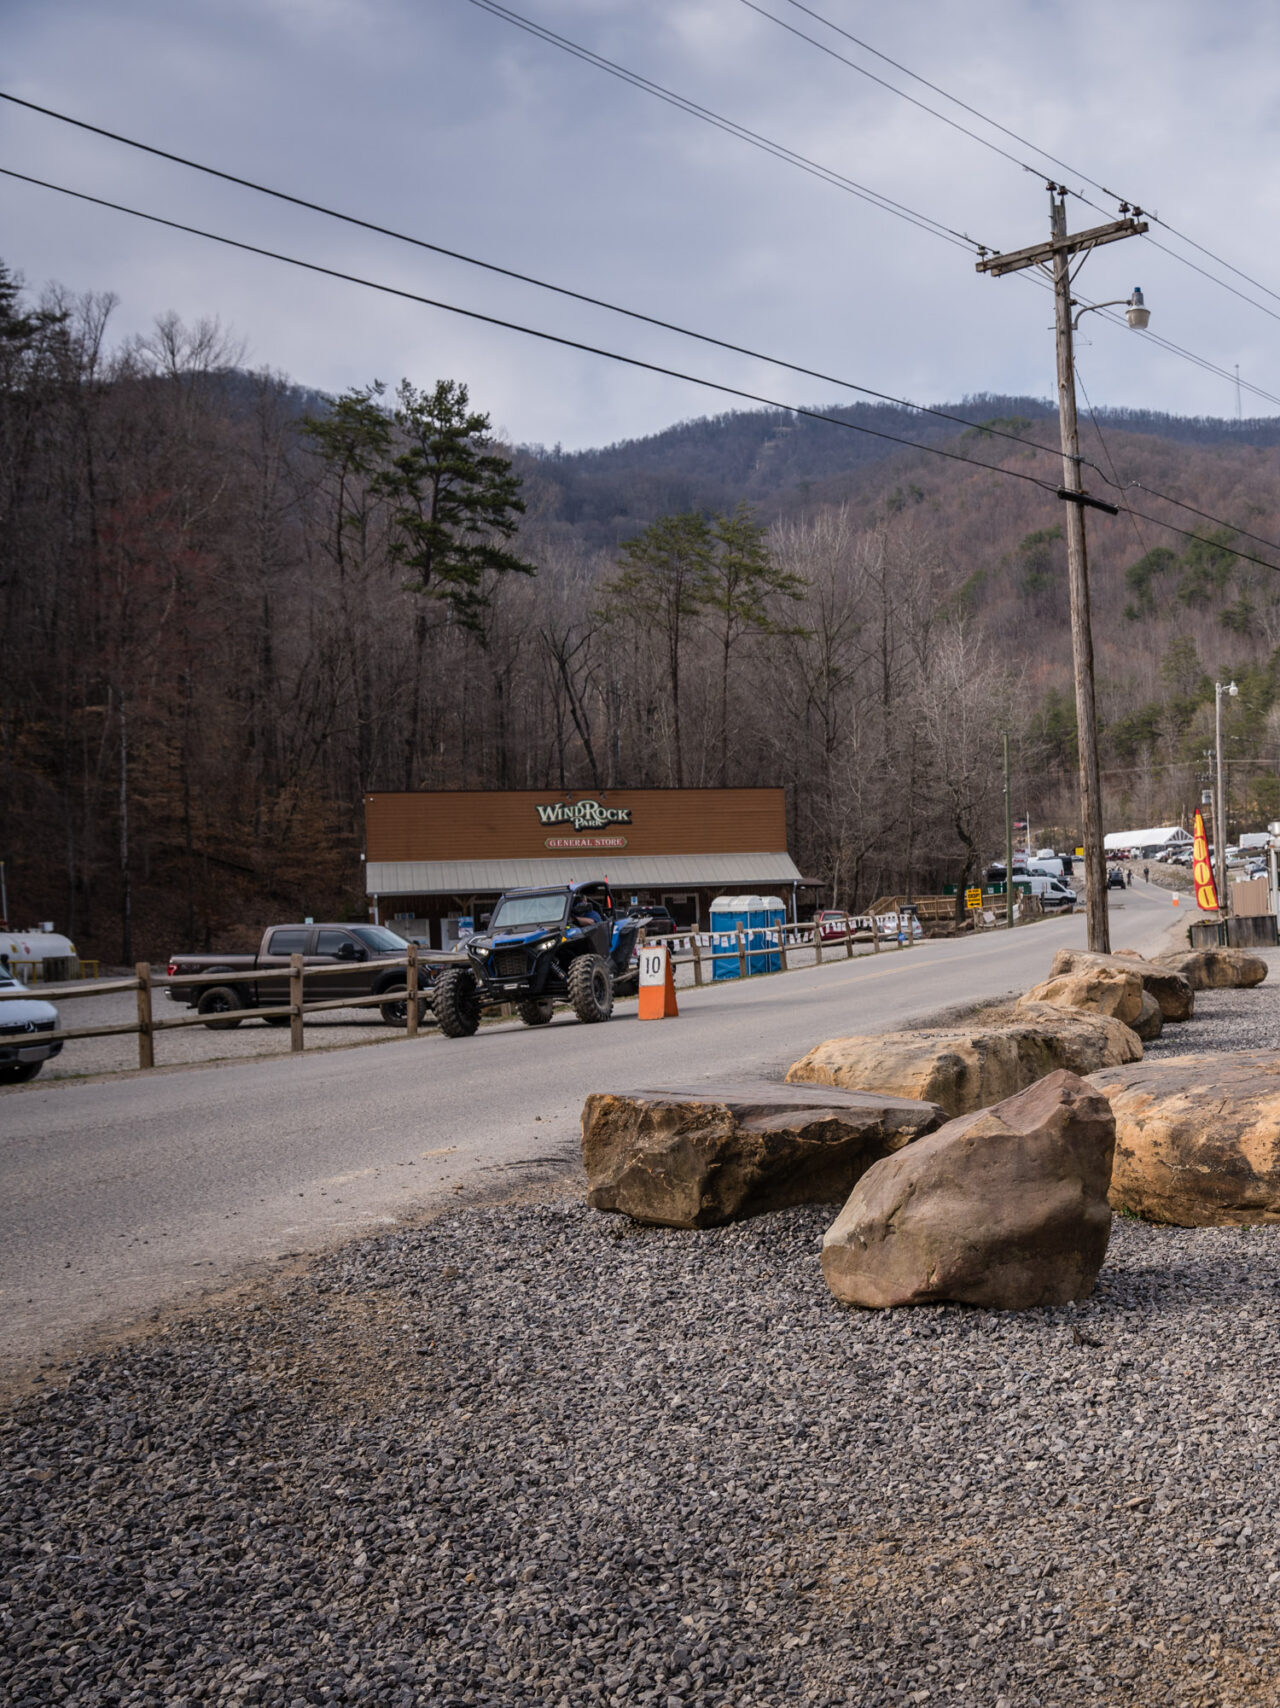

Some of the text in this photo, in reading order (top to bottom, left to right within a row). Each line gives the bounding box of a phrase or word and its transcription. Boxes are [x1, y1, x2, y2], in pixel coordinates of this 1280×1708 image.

[549, 838, 622, 848] GENERAL STORE
[646, 956, 660, 974] 10
